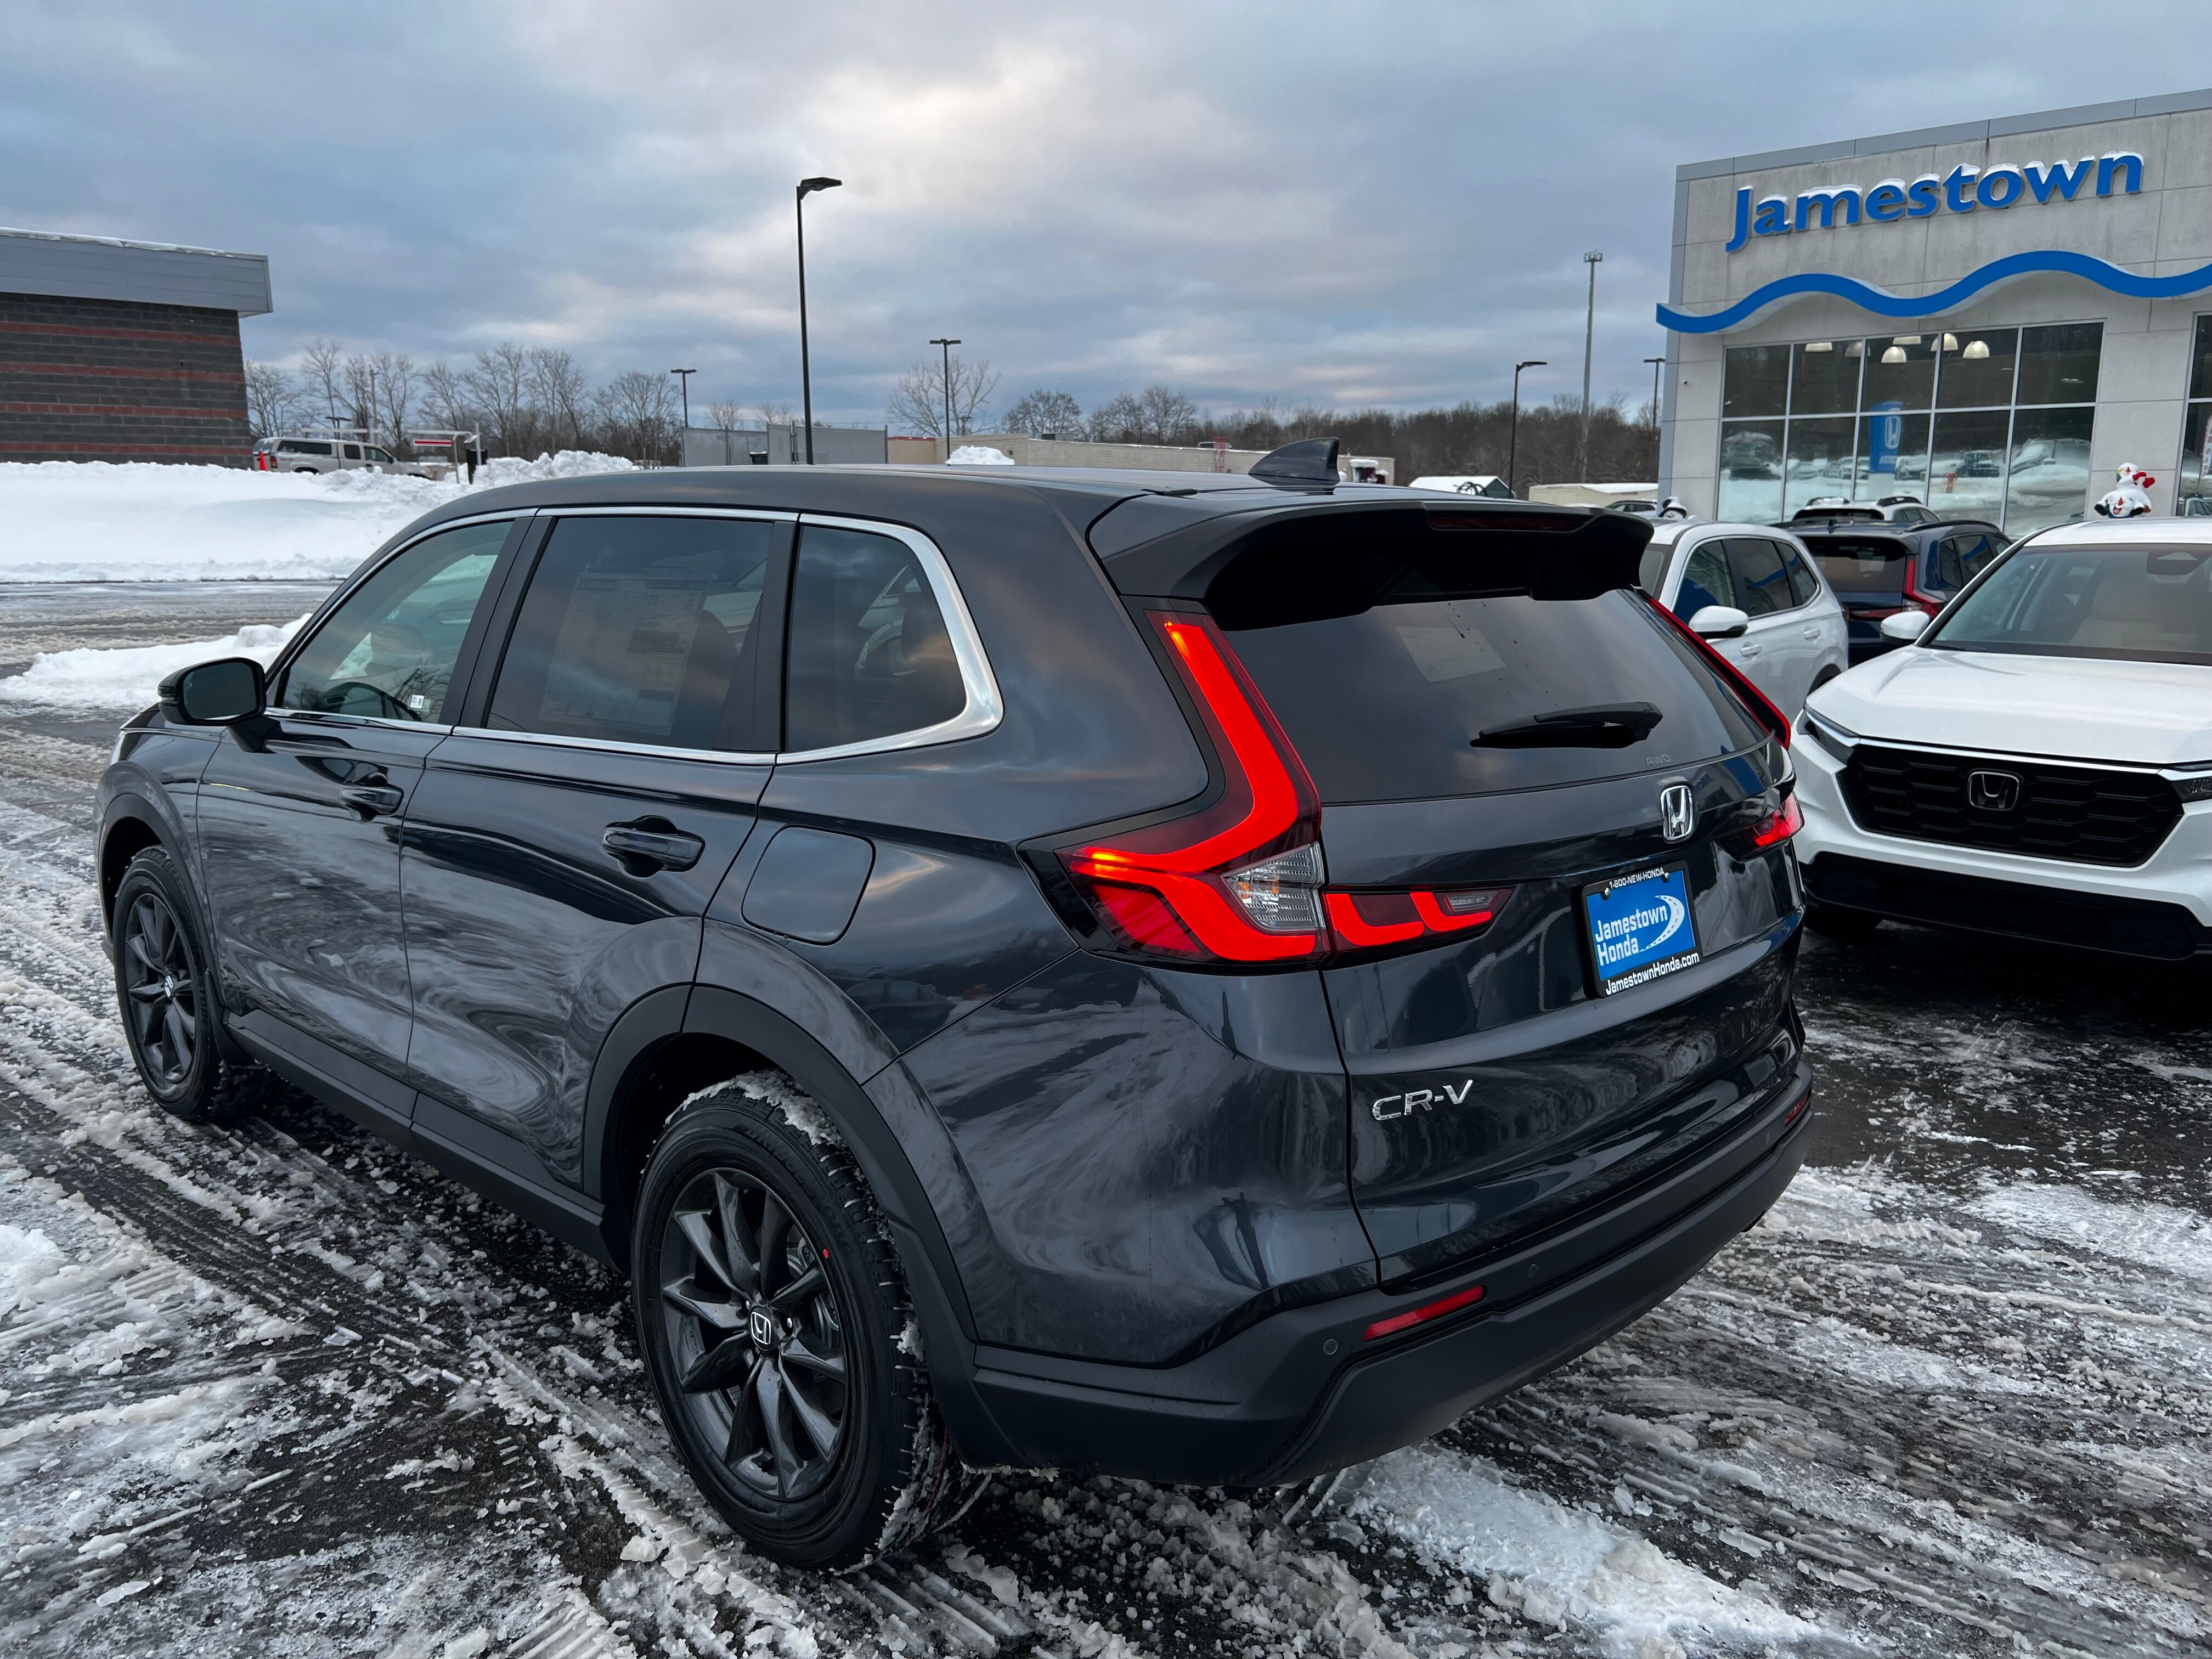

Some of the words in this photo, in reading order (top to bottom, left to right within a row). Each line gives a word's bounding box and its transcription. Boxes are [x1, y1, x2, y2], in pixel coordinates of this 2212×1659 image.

[1725, 152, 2144, 252] Jamestown
[1646, 754, 1671, 765] AWD
[1609, 867, 1664, 889] 1-800-NEW-HONDA
[1595, 905, 1668, 943] Jamestown
[1597, 934, 1639, 966] Honda
[1606, 952, 1700, 995] JamestownHonda.com
[1373, 1079, 1473, 1121] CR-V
